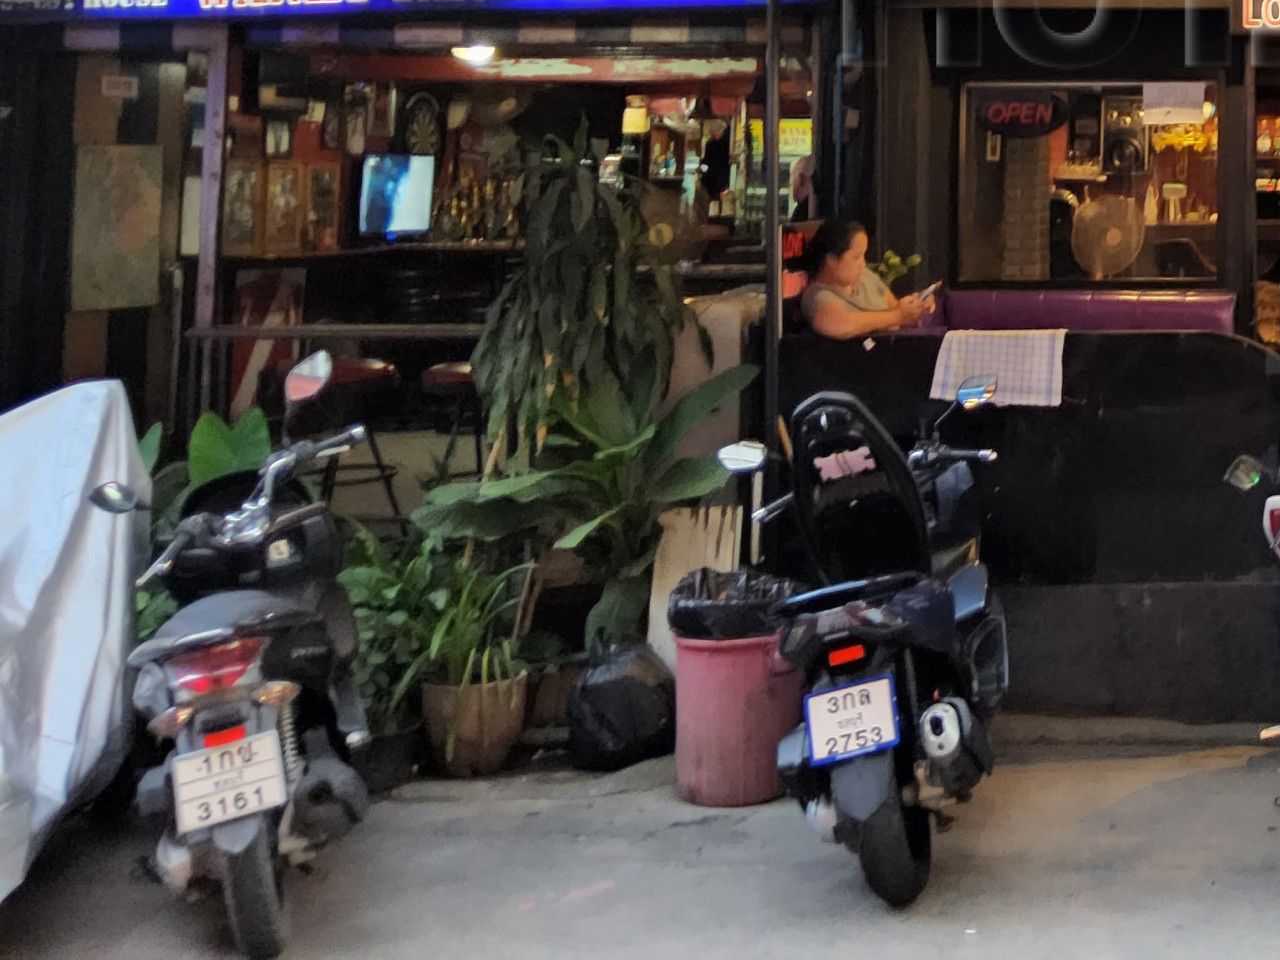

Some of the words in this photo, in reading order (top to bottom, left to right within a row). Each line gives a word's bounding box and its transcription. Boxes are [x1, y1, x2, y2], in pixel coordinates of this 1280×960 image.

[986, 101, 1053, 124] OPEN
[825, 726, 884, 756] 2753
[196, 785, 267, 822] 3161
